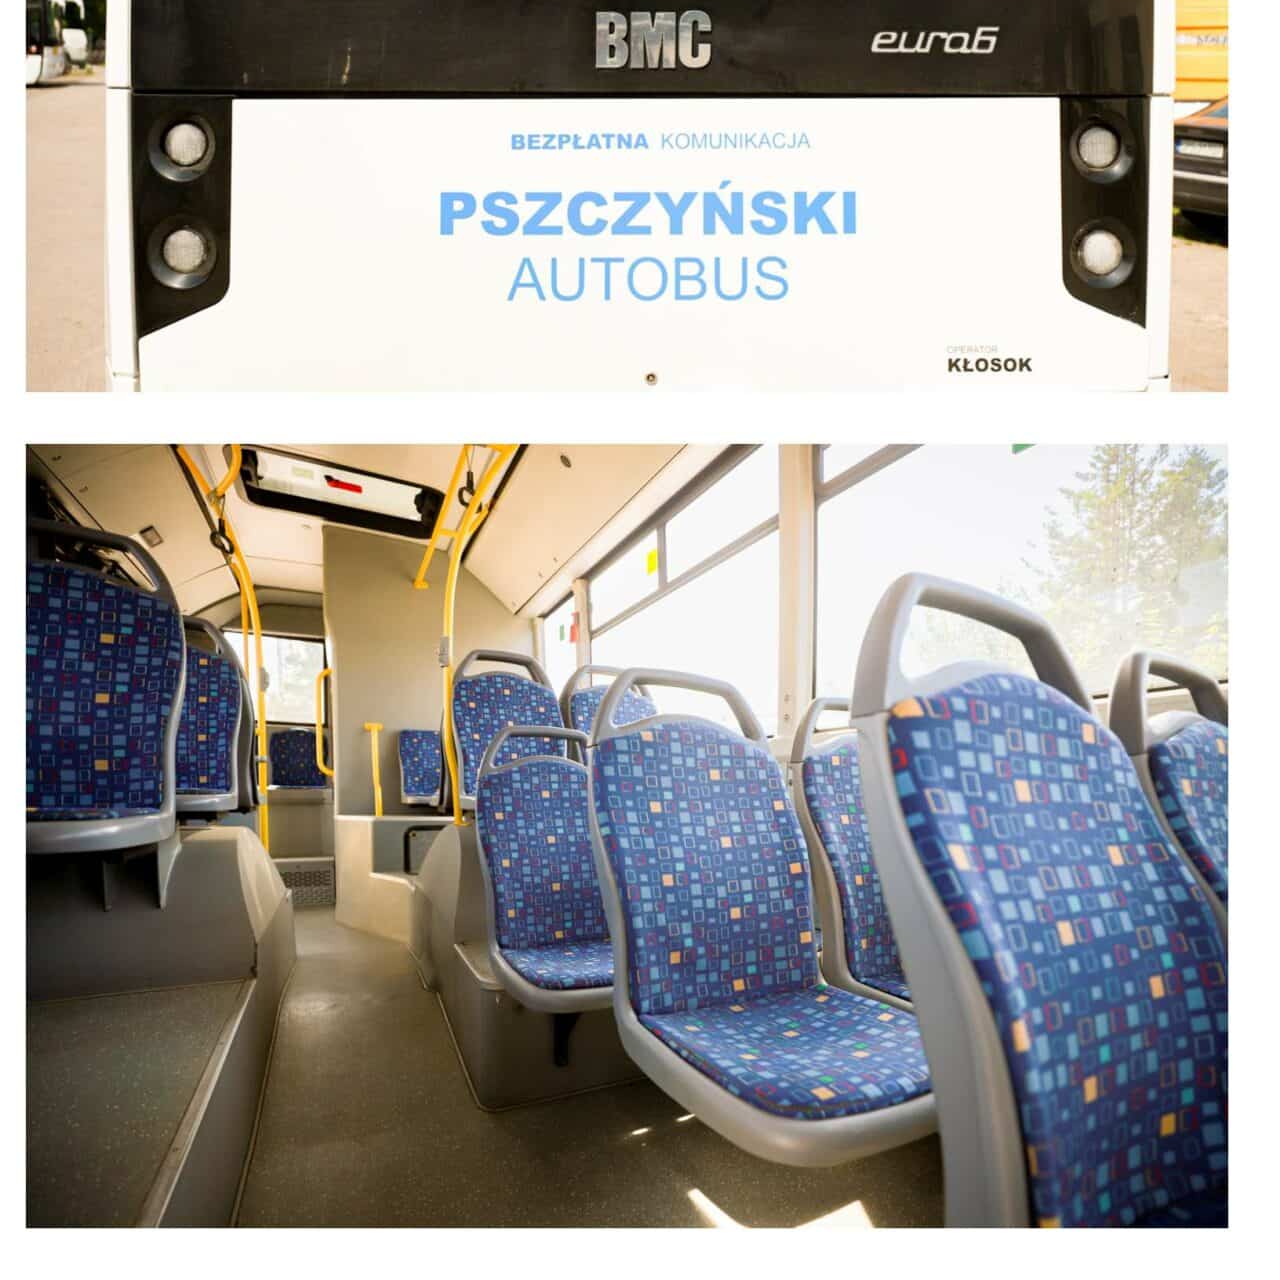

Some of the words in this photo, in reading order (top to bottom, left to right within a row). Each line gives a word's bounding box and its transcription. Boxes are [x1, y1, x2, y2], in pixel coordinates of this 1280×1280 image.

[595, 10, 712, 69] BMC
[510, 133, 649, 150] BEZPŁATNA
[660, 132, 811, 150] KOMUNIKACJA
[439, 180, 857, 236] PSZCZYŃSKI
[507, 256, 790, 301] AUTOBUS
[947, 357, 1033, 373] KŁOSOK
